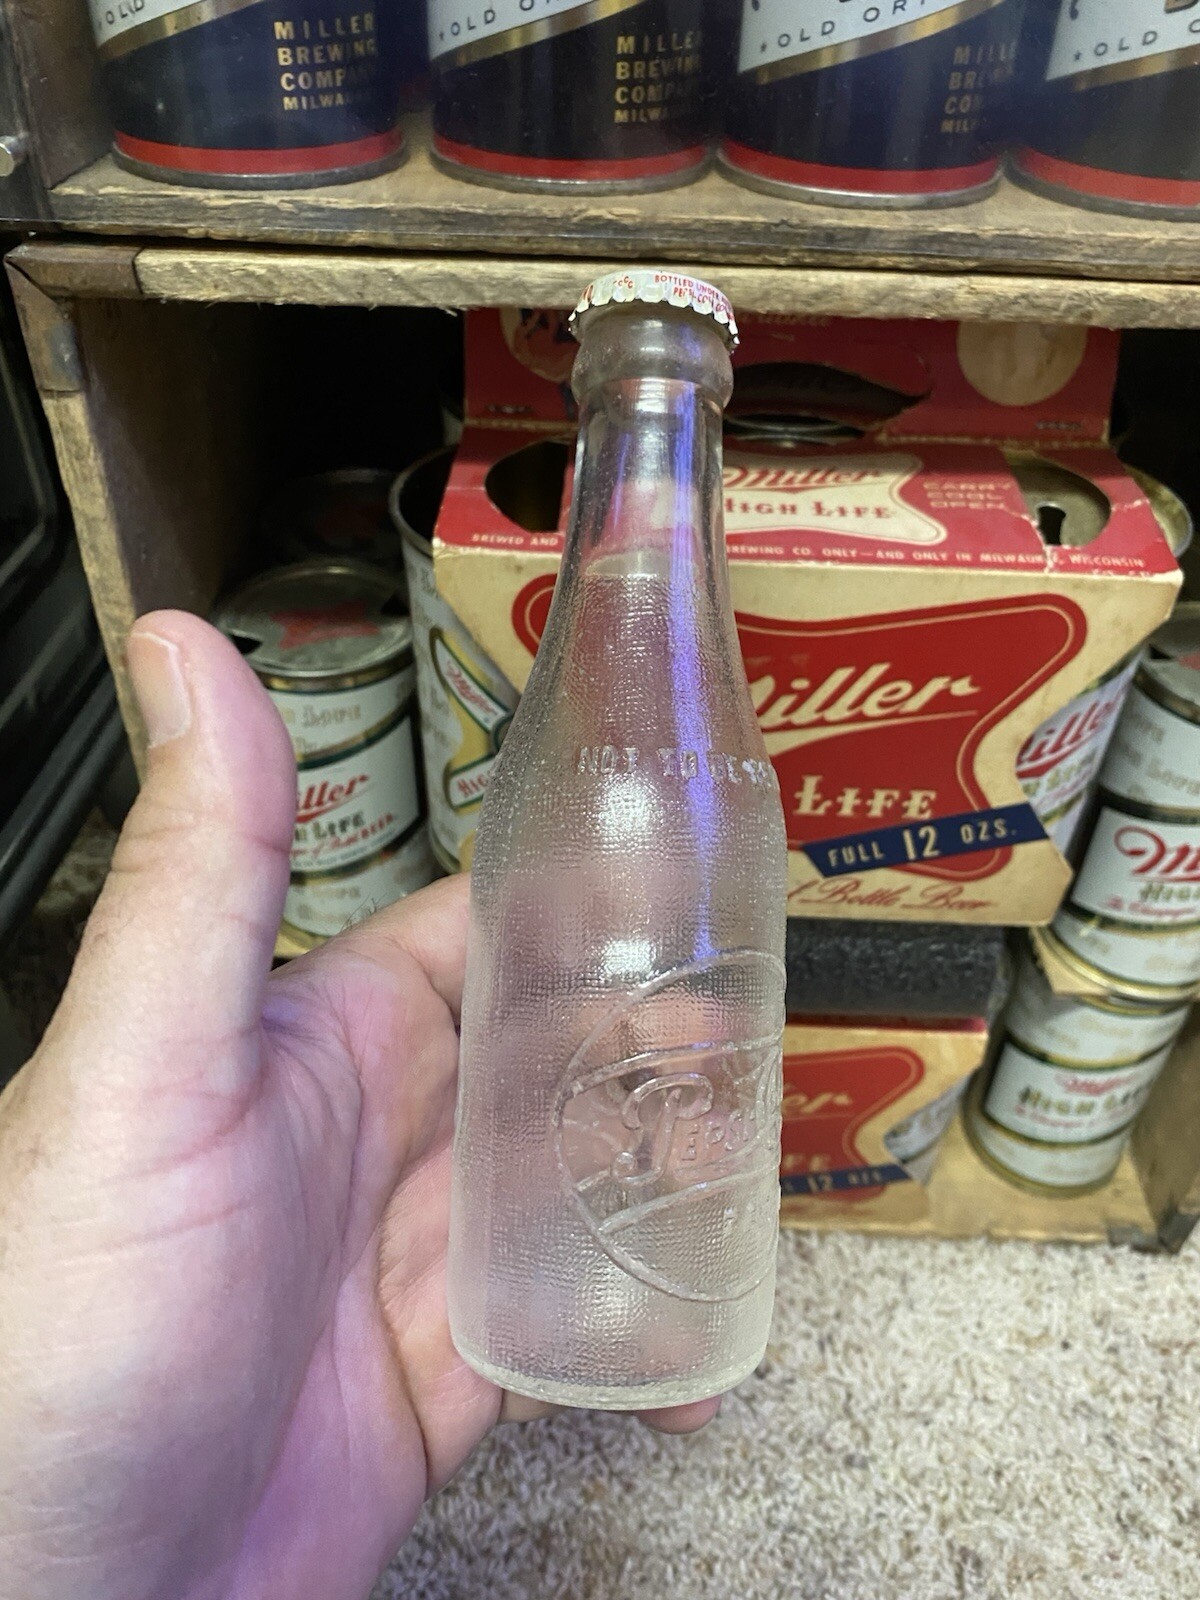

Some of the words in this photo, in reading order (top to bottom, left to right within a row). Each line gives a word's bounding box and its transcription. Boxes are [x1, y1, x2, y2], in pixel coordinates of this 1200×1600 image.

[273, 12, 374, 39] MILLER
[450, 9, 496, 36] OLD
[777, 21, 835, 47] OLD
[616, 31, 701, 54] MILLE
[1094, 30, 1158, 56] OLD
[280, 68, 350, 91] COMP
[283, 93, 346, 110] MILWA
[654, 274, 694, 288] BOTTLED
[696, 283, 719, 300] UNDER
[812, 500, 892, 519] LIFE
[471, 533, 524, 547] BREWED
[530, 535, 559, 547] AND
[822, 548, 857, 558] ONLY
[912, 551, 949, 562] ONLY
[956, 552, 971, 562] IN
[1070, 554, 1145, 568] WISCONSIN
[577, 745, 639, 776] NOT
[658, 747, 698, 779] TO
[792, 774, 938, 820] LIFE
[827, 843, 885, 869] FULL
[902, 825, 940, 862] 12
[960, 818, 1018, 845] OZS.
